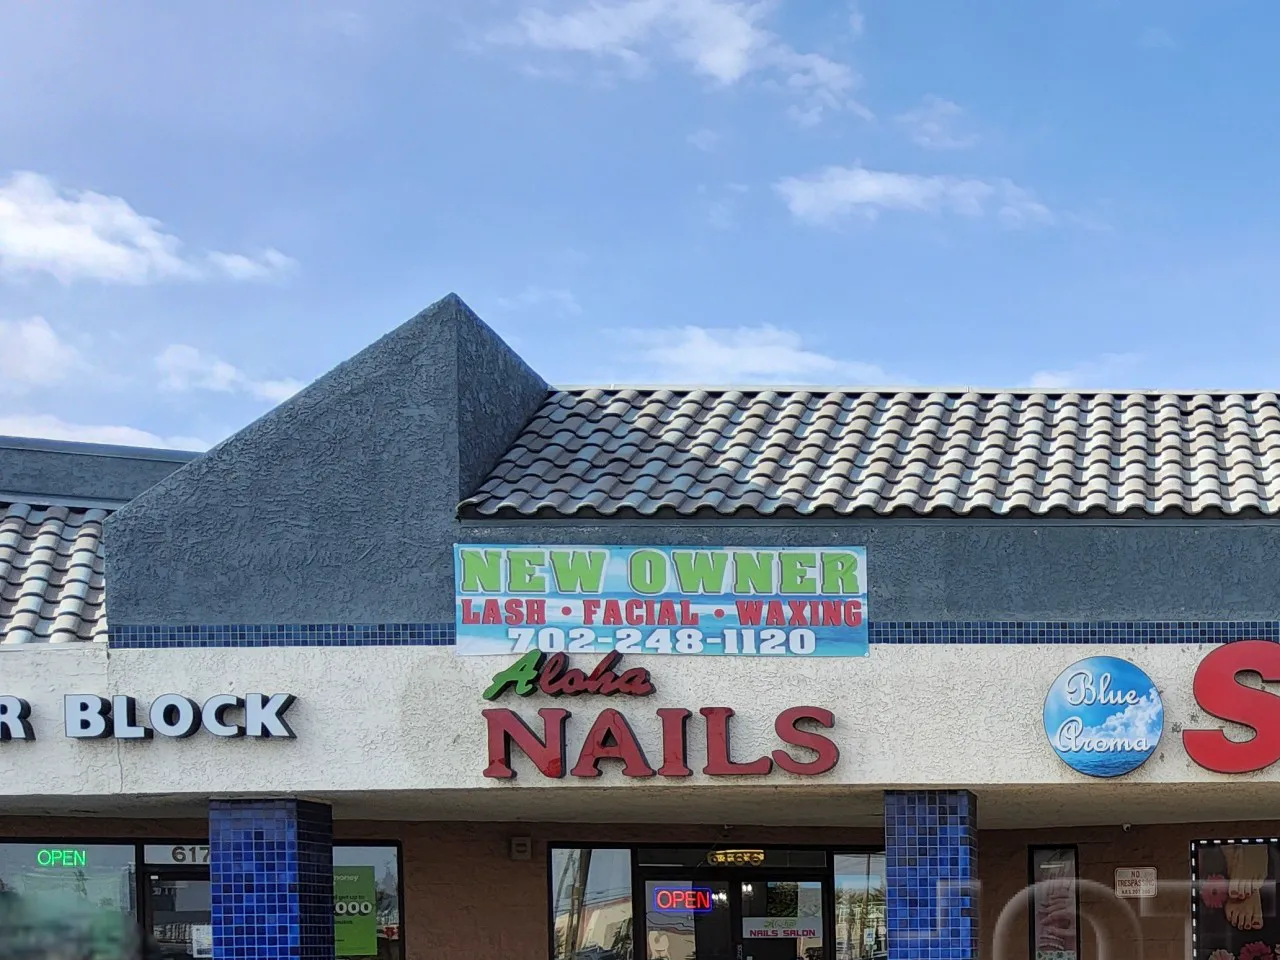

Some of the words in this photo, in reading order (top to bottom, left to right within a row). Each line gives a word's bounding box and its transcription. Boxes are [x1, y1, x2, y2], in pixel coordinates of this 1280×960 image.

[459, 548, 607, 595] NEW
[629, 548, 861, 595] OWNER
[462, 599, 546, 625] LASH
[583, 599, 700, 626] FACIAL
[736, 600, 862, 627] WAXING
[508, 628, 816, 654] 702-248-1120
[482, 648, 656, 700] Aloha
[1066, 669, 1141, 706] Blue
[64, 693, 297, 739] BLOCK
[482, 706, 840, 779] NAILS
[1056, 715, 1156, 753] Aroma
[37, 849, 86, 866] OPEN
[171, 846, 210, 863] 617
[657, 890, 710, 909] OPEN
[750, 929, 778, 937] NAILS
[783, 929, 816, 937] SALON
